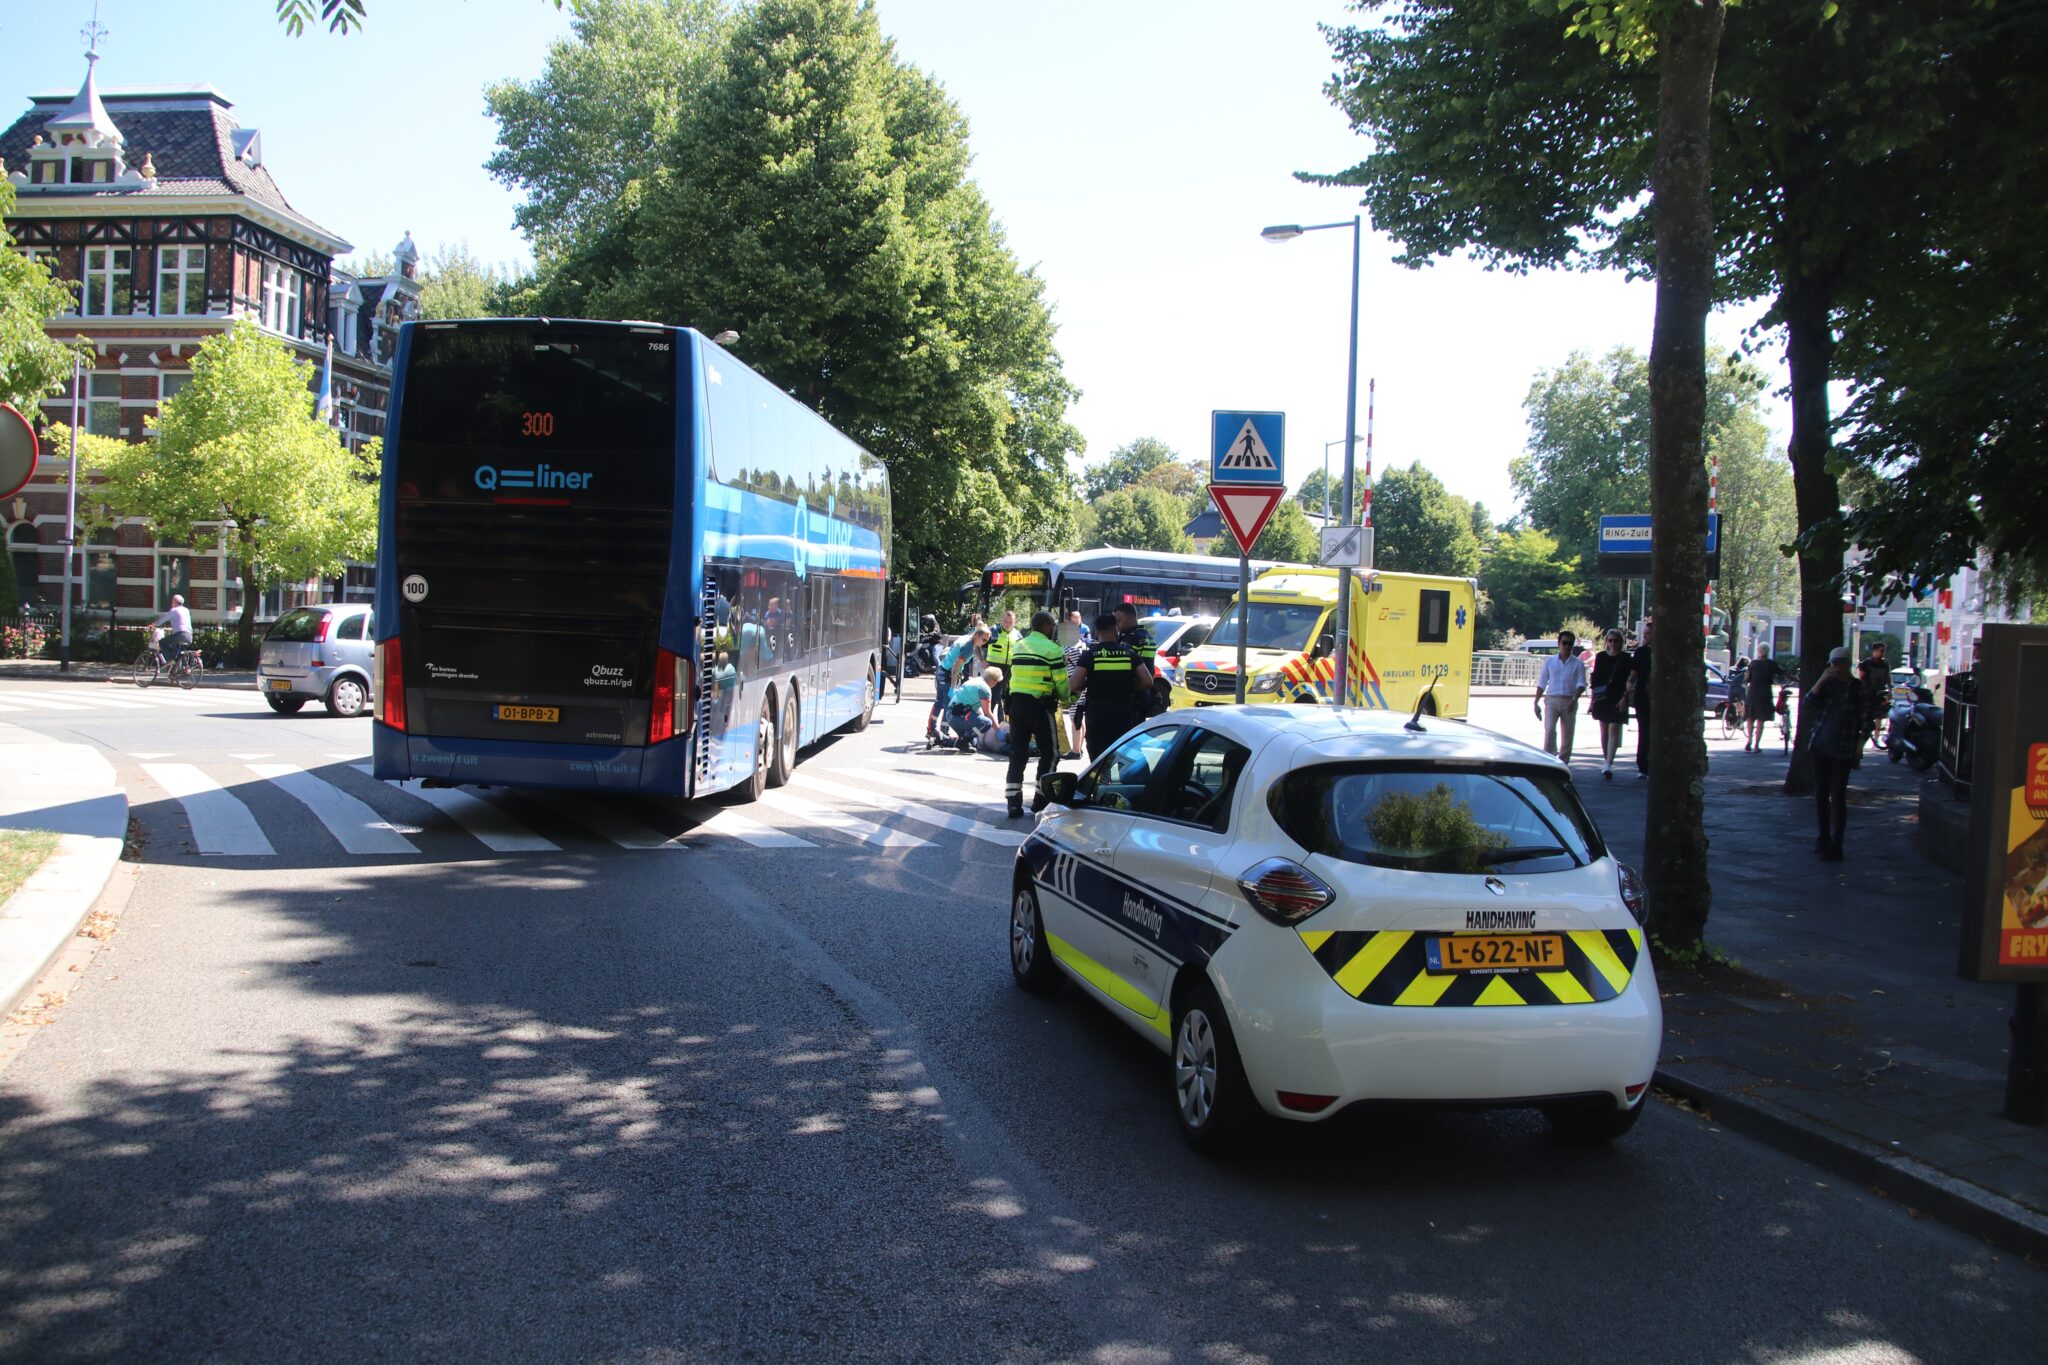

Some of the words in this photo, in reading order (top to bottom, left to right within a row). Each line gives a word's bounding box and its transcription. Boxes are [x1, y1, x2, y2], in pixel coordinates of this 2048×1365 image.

[648, 342, 670, 351] 7686
[522, 412, 554, 436] 300
[1605, 529, 1649, 538] RING-Zuid
[1008, 571, 1039, 585] Vinkhuizen
[405, 582, 425, 594] 100
[591, 664, 624, 677] Qbuzz
[1383, 670, 1416, 678] AMBULANCE
[1421, 664, 1449, 677] 01-129
[583, 676, 633, 688] qbuzz.nl/gd
[504, 707, 555, 720] 01-BPB-2
[585, 732, 621, 740] astromega
[421, 752, 461, 764] zwenkt
[463, 755, 479, 765] uit
[569, 762, 610, 773] zwenkt
[612, 764, 628, 774] uit
[1122, 891, 1163, 940] Handhaving
[1466, 910, 1536, 929] HANDHAVING
[1429, 957, 1440, 965] NL
[1448, 940, 1553, 964] L-622-NF
